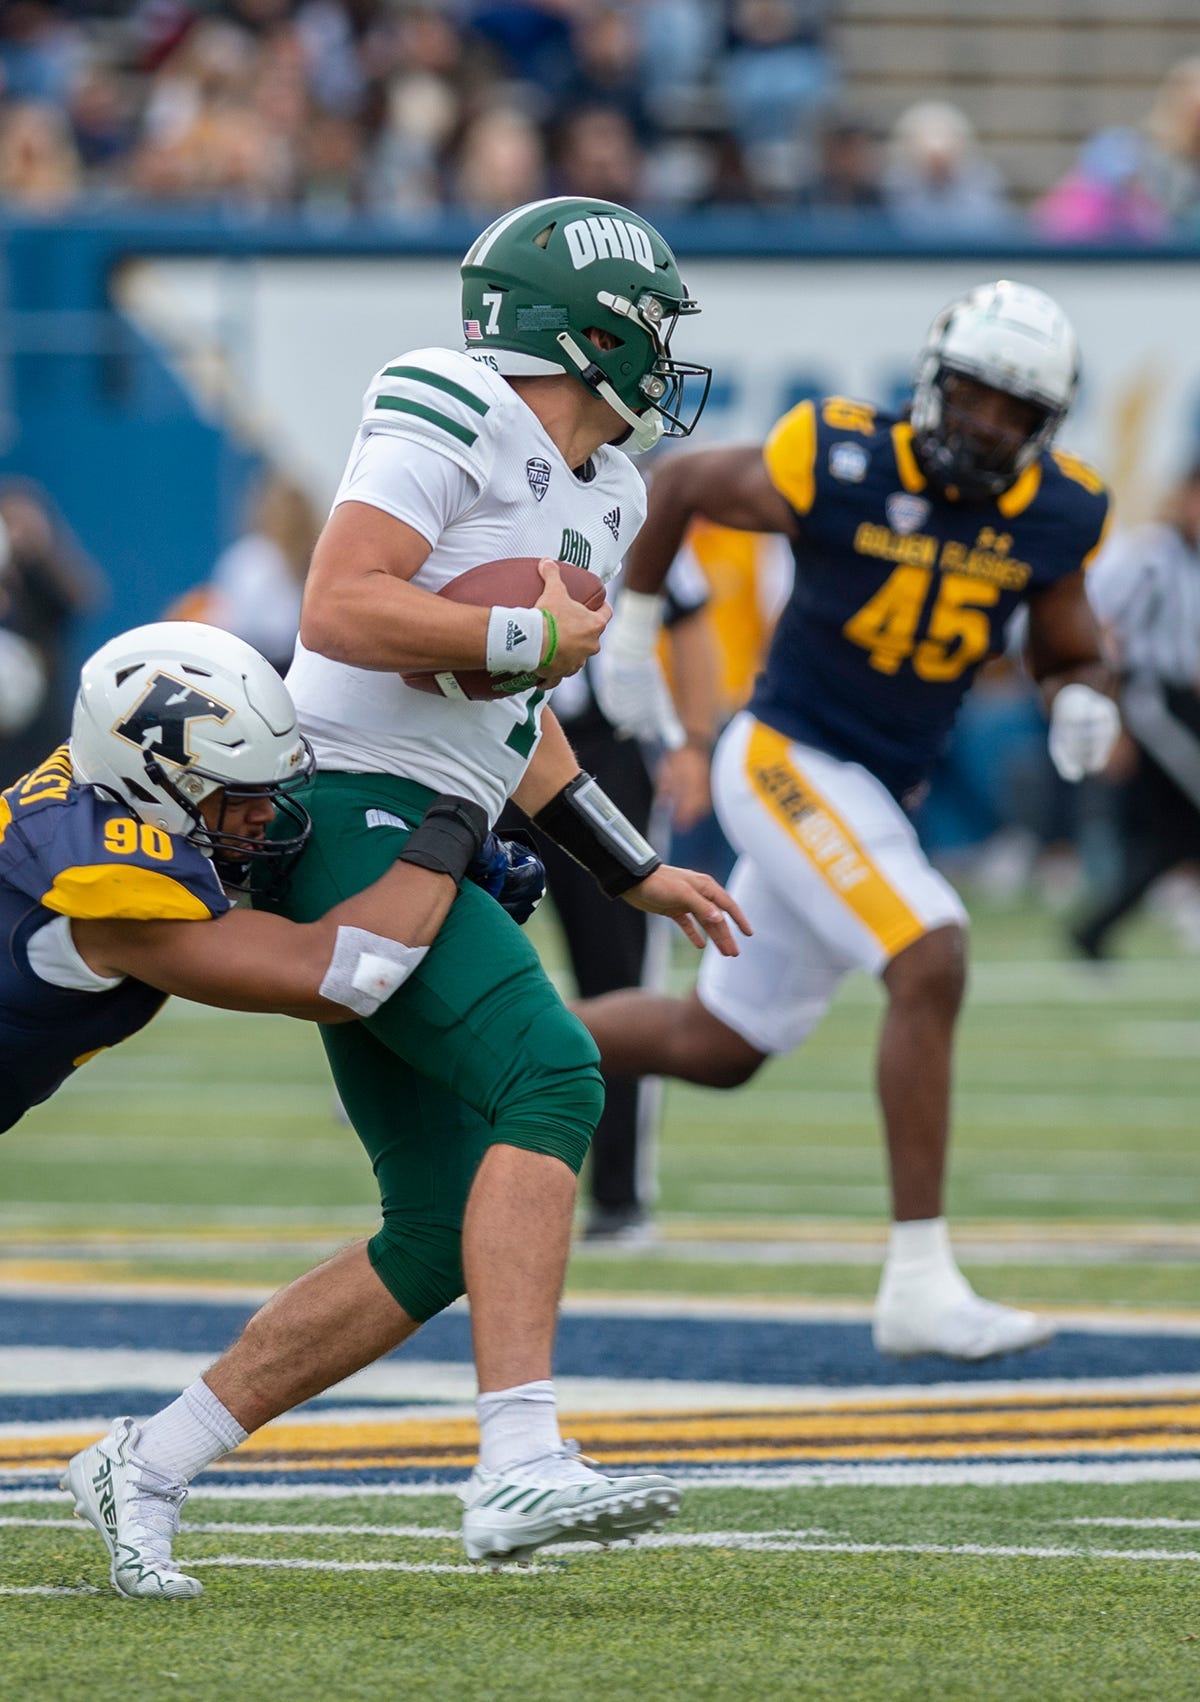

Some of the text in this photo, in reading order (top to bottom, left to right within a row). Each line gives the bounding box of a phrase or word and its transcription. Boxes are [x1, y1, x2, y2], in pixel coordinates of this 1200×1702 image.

[563, 217, 656, 274] OHIO
[482, 293, 503, 335] 7
[558, 527, 592, 570] OHIO
[841, 563, 1001, 683] 45
[109, 669, 236, 769] K
[103, 817, 175, 861] 90
